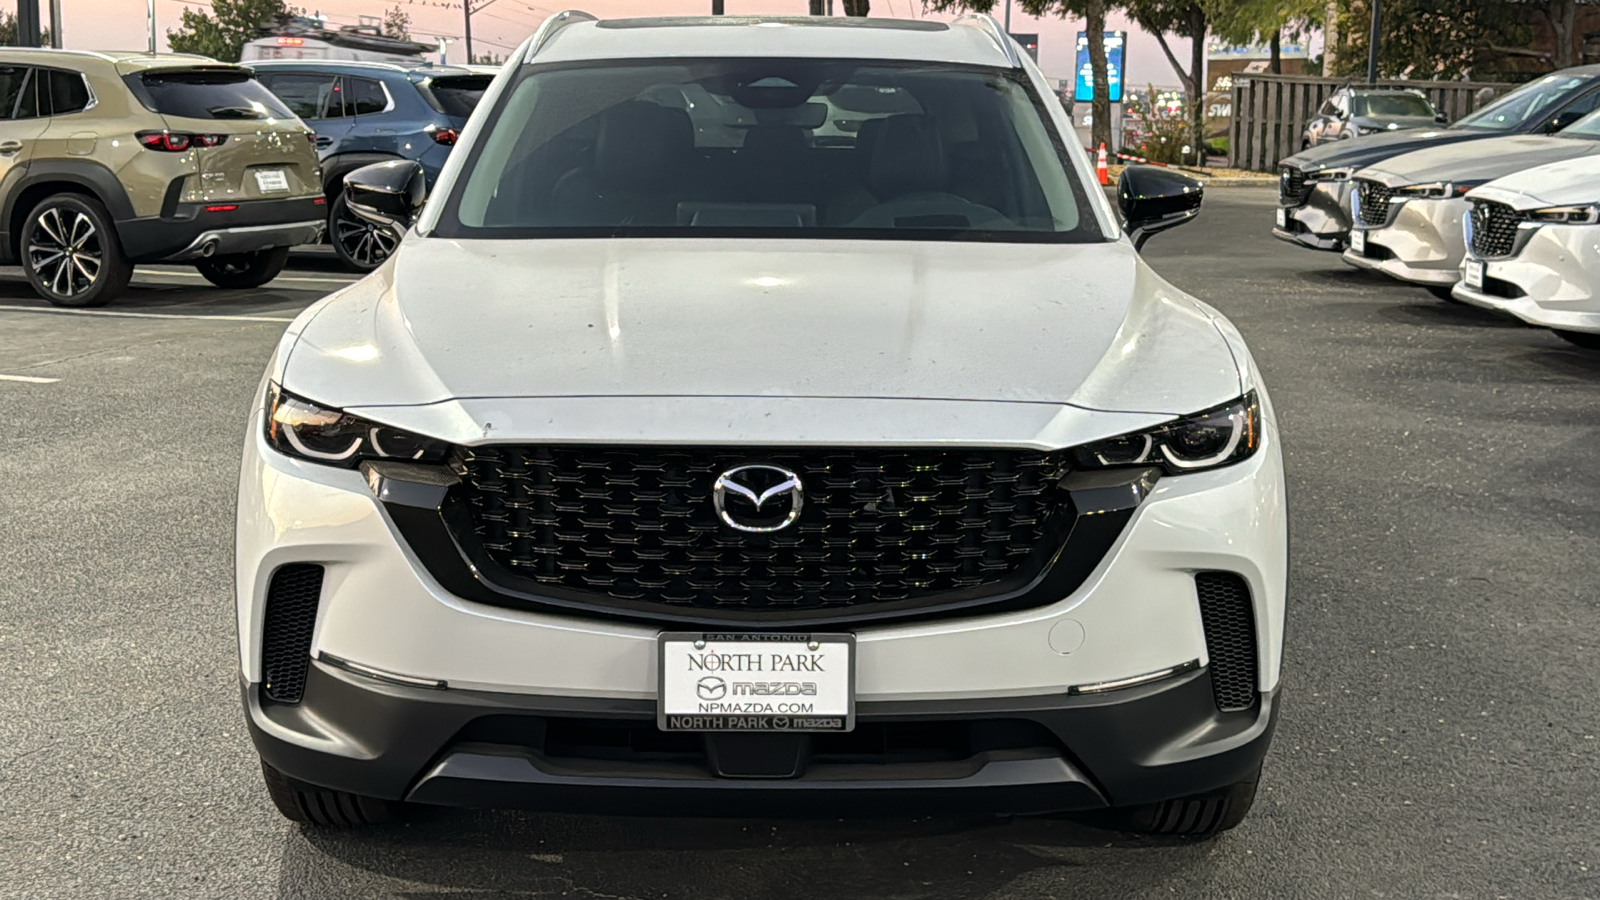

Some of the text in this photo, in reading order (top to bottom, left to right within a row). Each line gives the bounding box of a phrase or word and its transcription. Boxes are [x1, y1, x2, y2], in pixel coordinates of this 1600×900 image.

[687, 653, 825, 672] NORTH PARK
[732, 682, 817, 696] mazda
[698, 703, 813, 713] NPMAZDA.COM
[670, 716, 842, 729] NORTH PARK mazda
